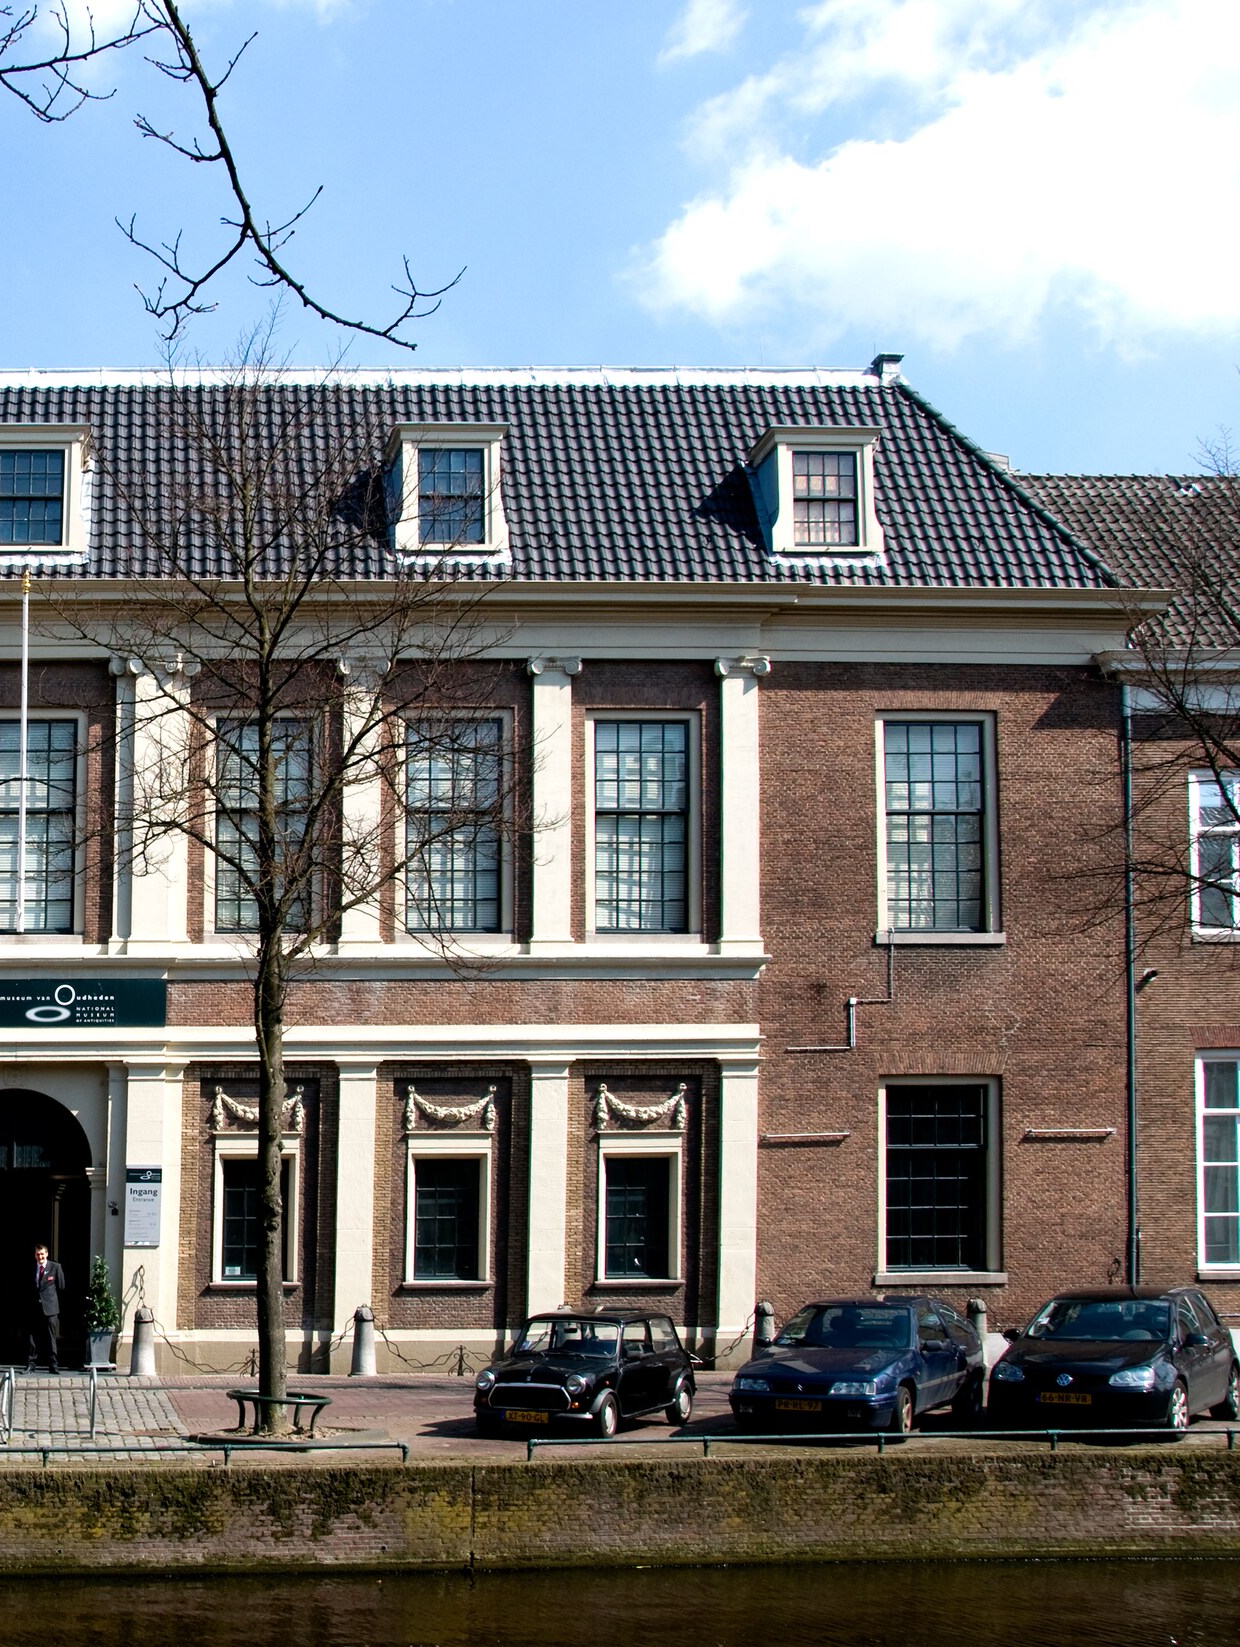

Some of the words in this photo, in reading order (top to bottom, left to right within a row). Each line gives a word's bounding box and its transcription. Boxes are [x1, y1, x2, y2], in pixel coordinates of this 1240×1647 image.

[54, 984, 115, 1006] Oudheden
[129, 1188, 158, 1197] Ingang
[509, 1412, 545, 1422] XT-90-GL
